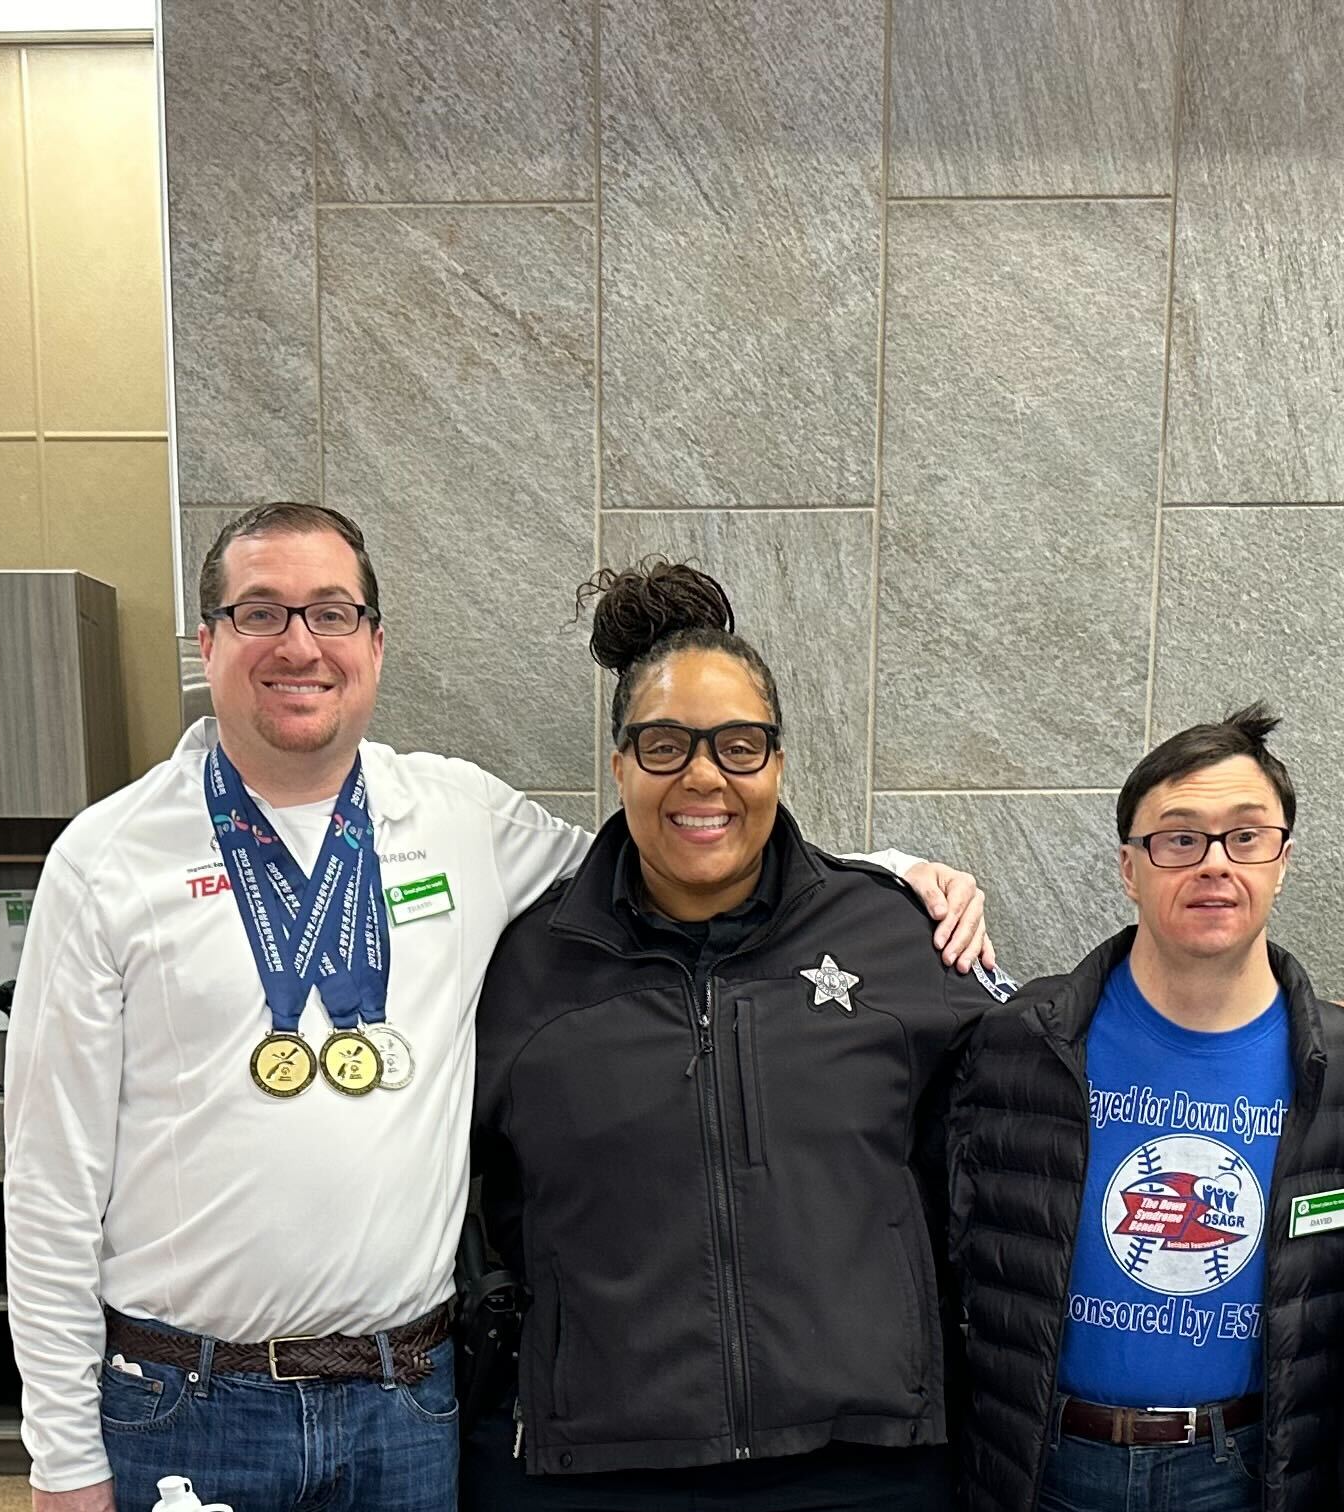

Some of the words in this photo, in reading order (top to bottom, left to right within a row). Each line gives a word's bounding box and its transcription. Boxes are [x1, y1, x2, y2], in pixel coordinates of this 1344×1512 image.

[1137, 1086, 1171, 1127] for
[1170, 1090, 1230, 1133] Down
[1178, 1298, 1216, 1348] by
